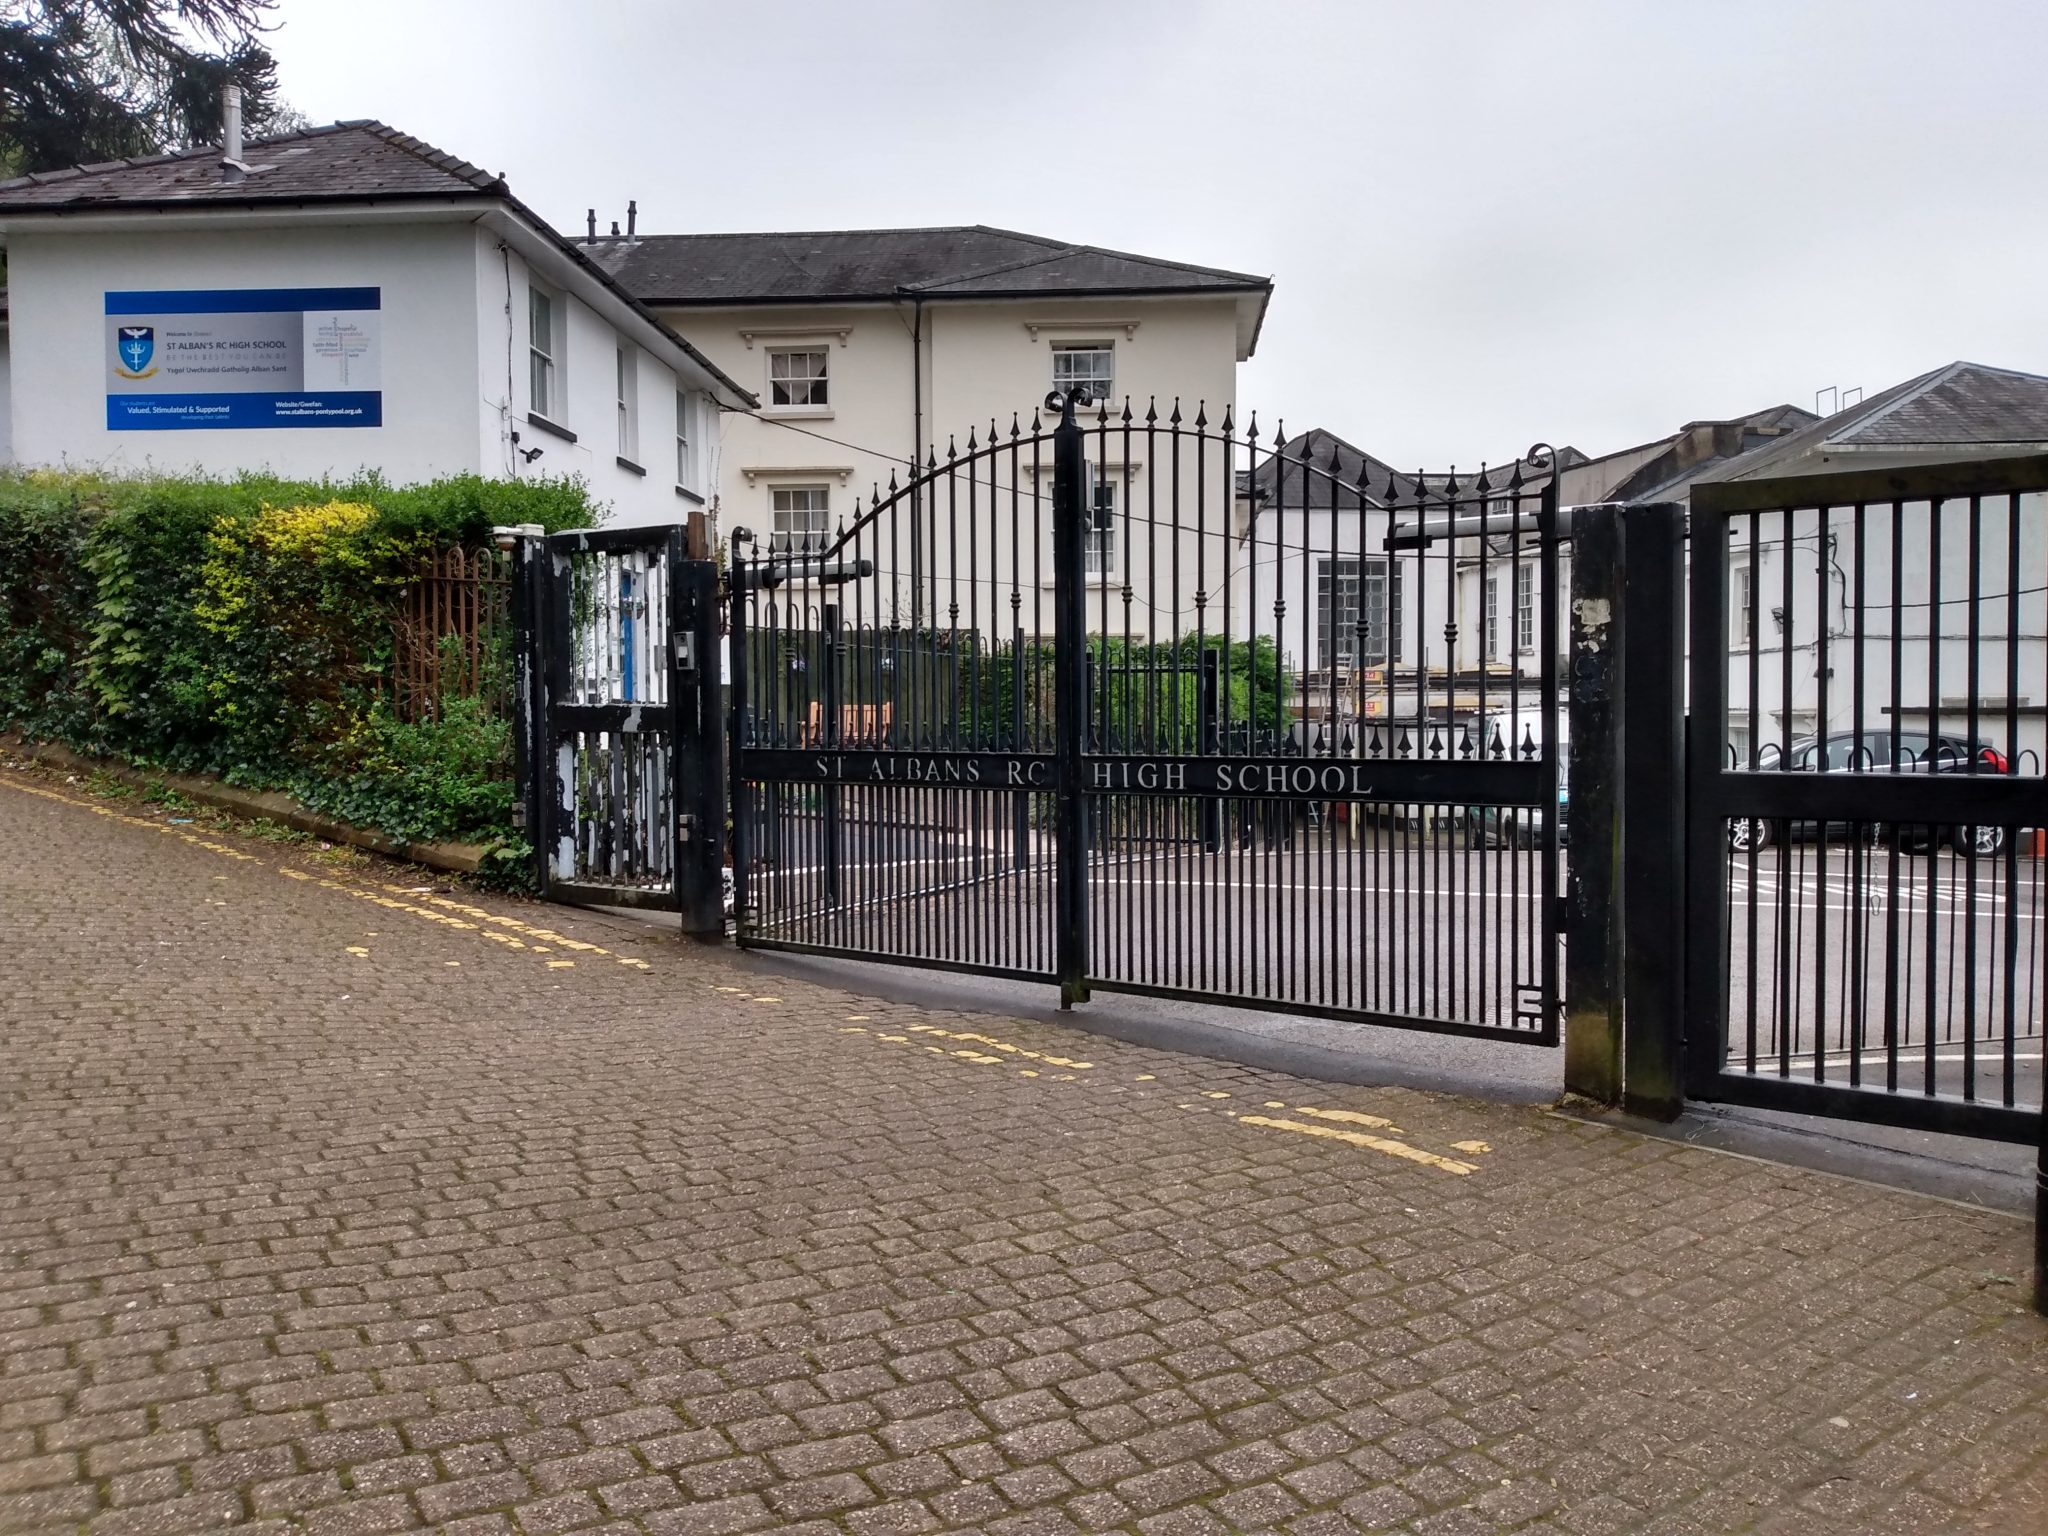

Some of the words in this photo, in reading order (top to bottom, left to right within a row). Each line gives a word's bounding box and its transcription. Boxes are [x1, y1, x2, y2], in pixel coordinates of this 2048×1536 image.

[166, 342, 177, 350] ST
[179, 342, 214, 350] ALBAN'S
[216, 341, 227, 350] RC
[229, 341, 250, 349] HIGH
[252, 340, 287, 349] SCHOOL
[152, 406, 187, 414] Stimulated
[195, 405, 230, 414] Supported
[816, 755, 847, 778] ST
[869, 758, 980, 783] ALBANS
[1007, 760, 1046, 786] RC
[1093, 762, 1187, 790] HIGH
[1216, 764, 1373, 795] SCHOOL
